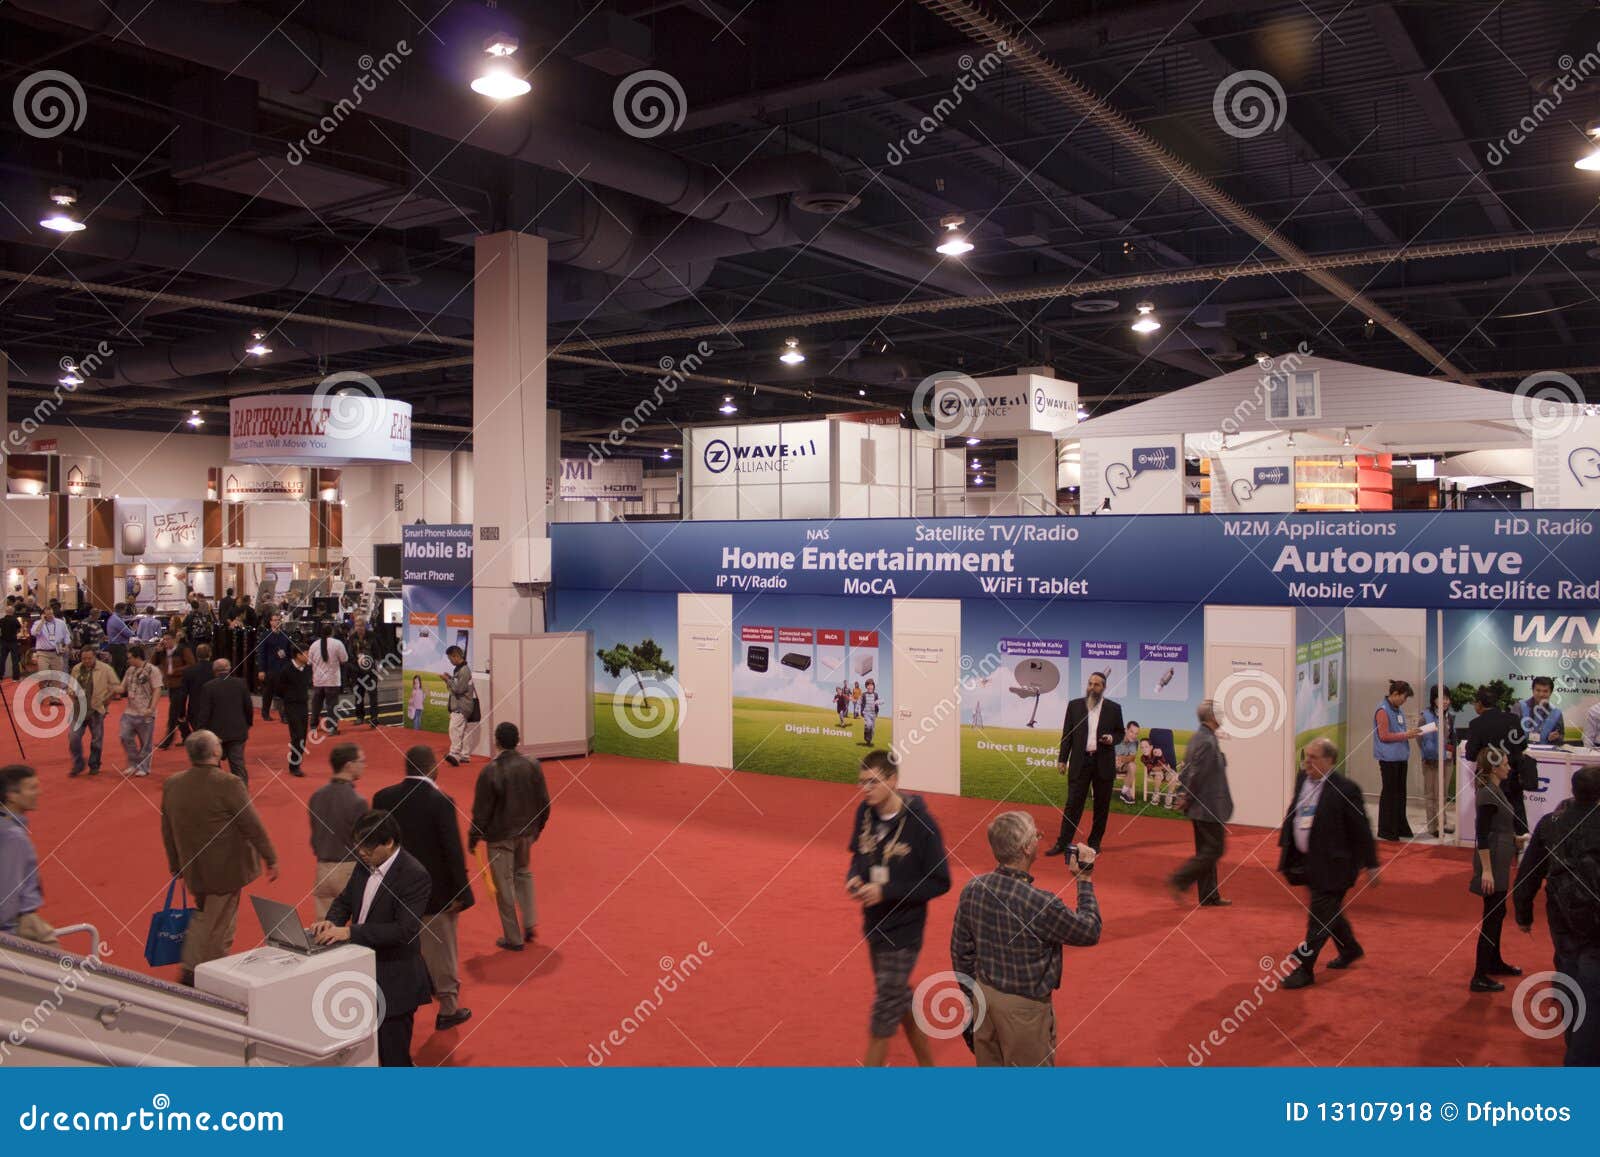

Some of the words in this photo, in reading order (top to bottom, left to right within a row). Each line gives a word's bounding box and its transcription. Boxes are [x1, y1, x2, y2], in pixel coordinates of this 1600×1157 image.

[233, 406, 331, 438] EARTHQUAKE
[266, 440, 280, 448] Will
[282, 439, 307, 448] Move
[309, 440, 327, 449] You
[733, 444, 789, 459] WAVE
[733, 459, 789, 473] ALLIANCE
[153, 511, 189, 526] GET
[405, 529, 424, 538] Smart
[424, 529, 446, 537] Phone
[1224, 521, 1270, 536] M2M
[1275, 520, 1397, 540] Applications
[1494, 519, 1529, 535] HD
[1536, 518, 1592, 535] Radio
[807, 529, 829, 541] NAS
[915, 525, 985, 541] Satellite
[990, 525, 1079, 545] TV/Radio
[404, 542, 453, 558] Mobile
[721, 547, 795, 570] Home
[802, 547, 1015, 572] Entertainment
[1272, 544, 1523, 574] Automotive
[404, 570, 426, 580] Smart
[428, 570, 455, 581] Phone
[716, 575, 728, 588] IP
[730, 575, 787, 590] TV/Radio
[843, 577, 896, 595] MoCA
[980, 576, 1022, 594] WiFi
[1028, 577, 1089, 595] Tablet
[1288, 582, 1354, 599] Mobile
[1360, 583, 1387, 599] TV
[1449, 579, 1550, 600] Satellite
[1513, 647, 1559, 658] Wistron
[785, 723, 821, 736] Digital
[822, 727, 853, 738] Home
[977, 740, 1014, 753] Direct
